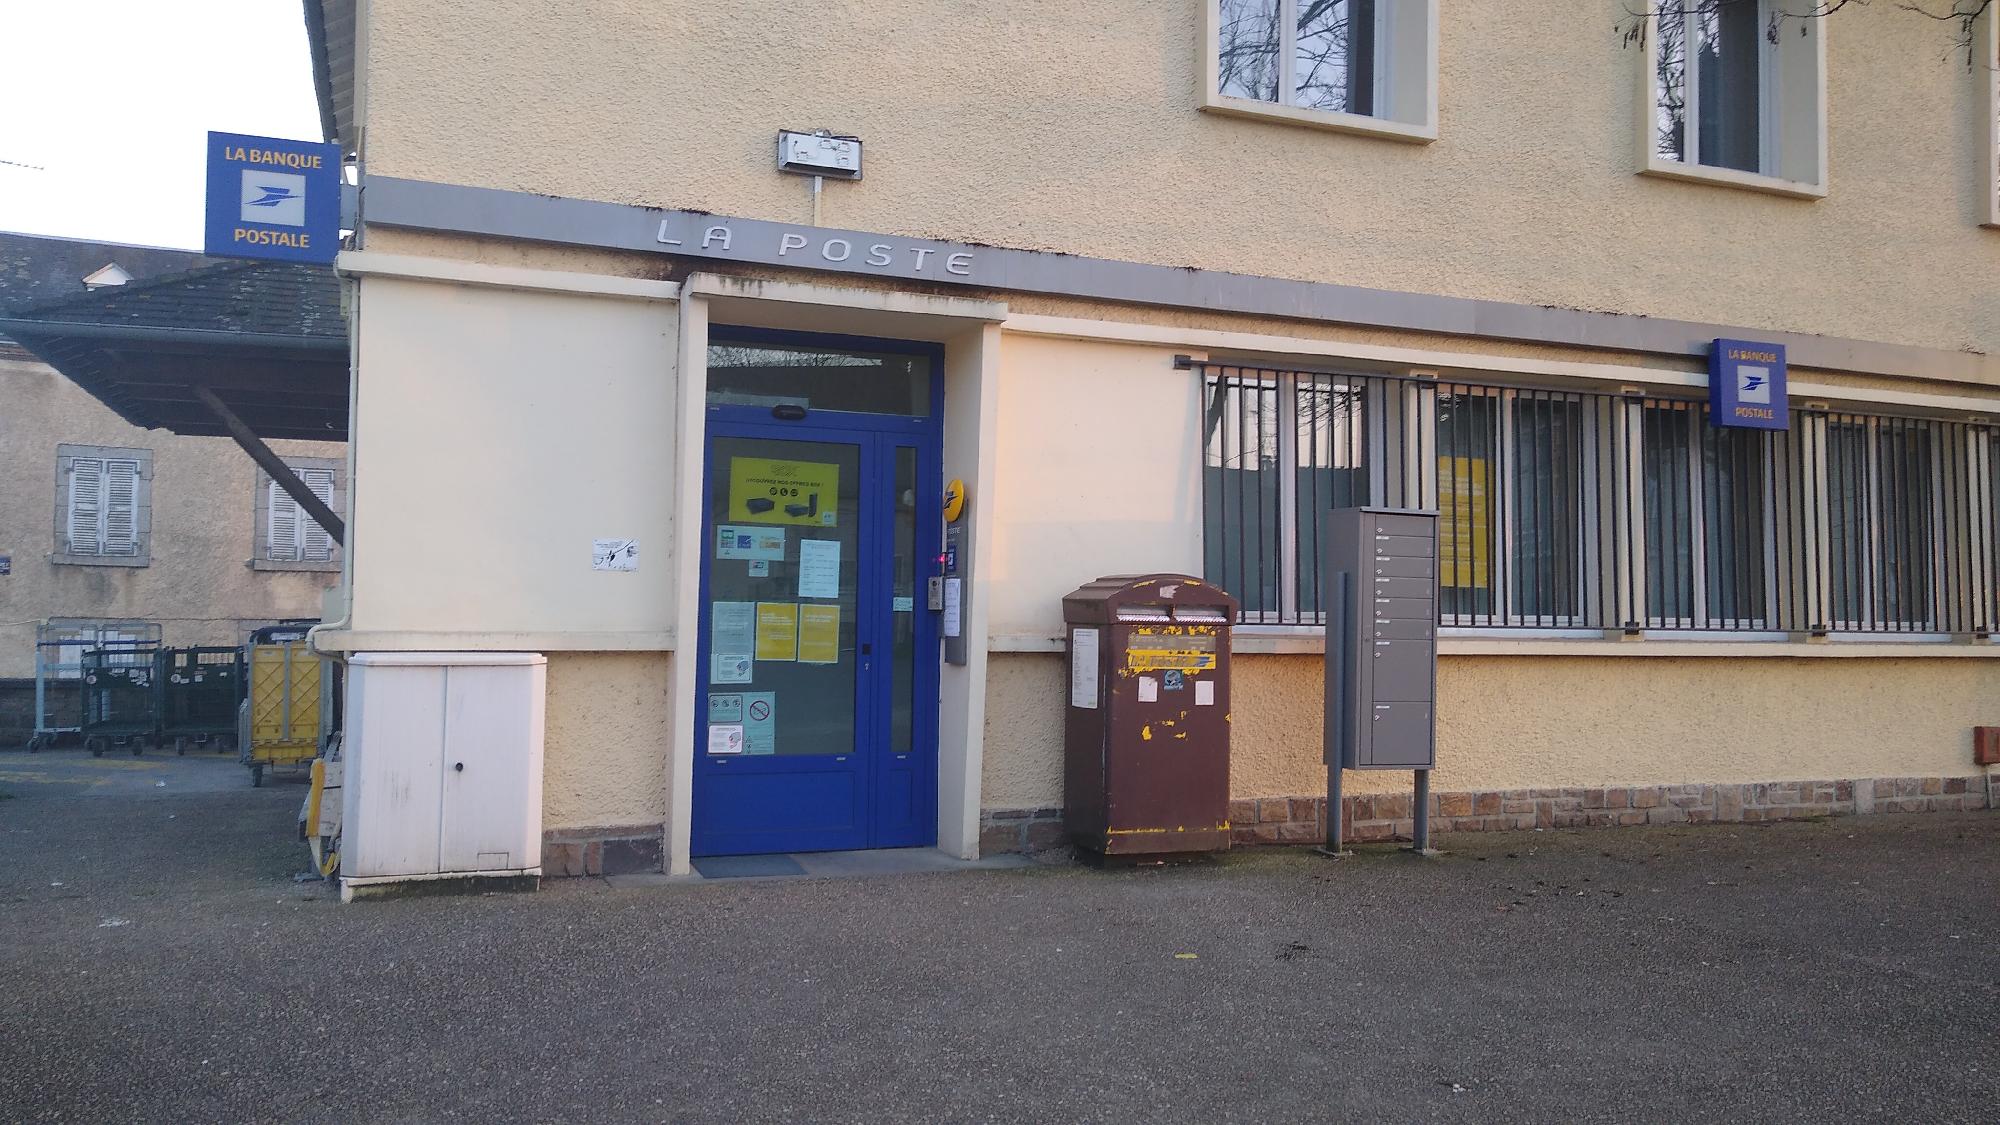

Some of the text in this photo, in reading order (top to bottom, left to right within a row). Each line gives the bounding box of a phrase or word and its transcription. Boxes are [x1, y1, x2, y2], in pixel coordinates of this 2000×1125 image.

[225, 146, 323, 169] LA BANQUE
[234, 228, 311, 249] POSTALE
[656, 219, 974, 275] LA POSTE
[1728, 349, 1777, 363] LA BANQUE
[1735, 407, 1774, 419] POSTALE
